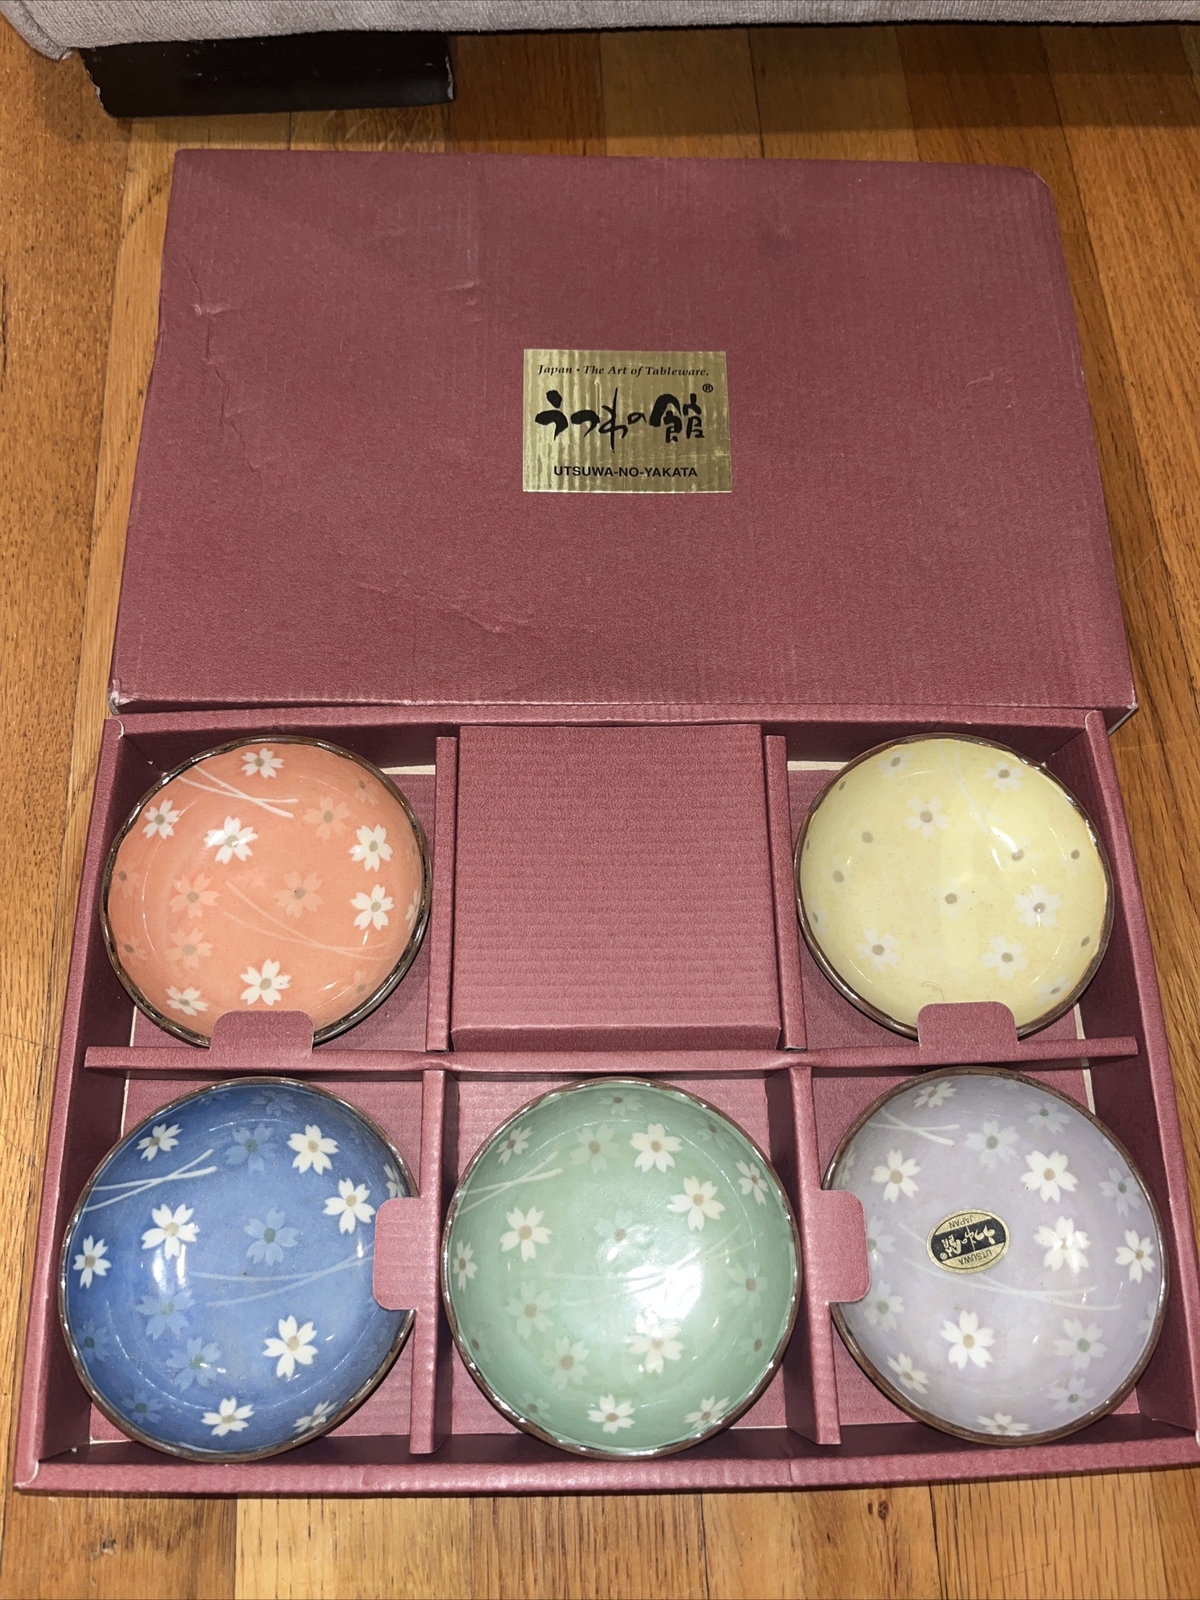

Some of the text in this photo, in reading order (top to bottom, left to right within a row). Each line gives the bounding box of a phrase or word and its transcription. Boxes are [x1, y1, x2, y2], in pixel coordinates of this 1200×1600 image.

[537, 364, 710, 378] Japan The Art of Tableware.
[553, 465, 699, 478] UTSUWA-NO-YAKATA
[948, 1215, 974, 1229] JAPAN
[958, 1248, 993, 1265] UTSUWA
